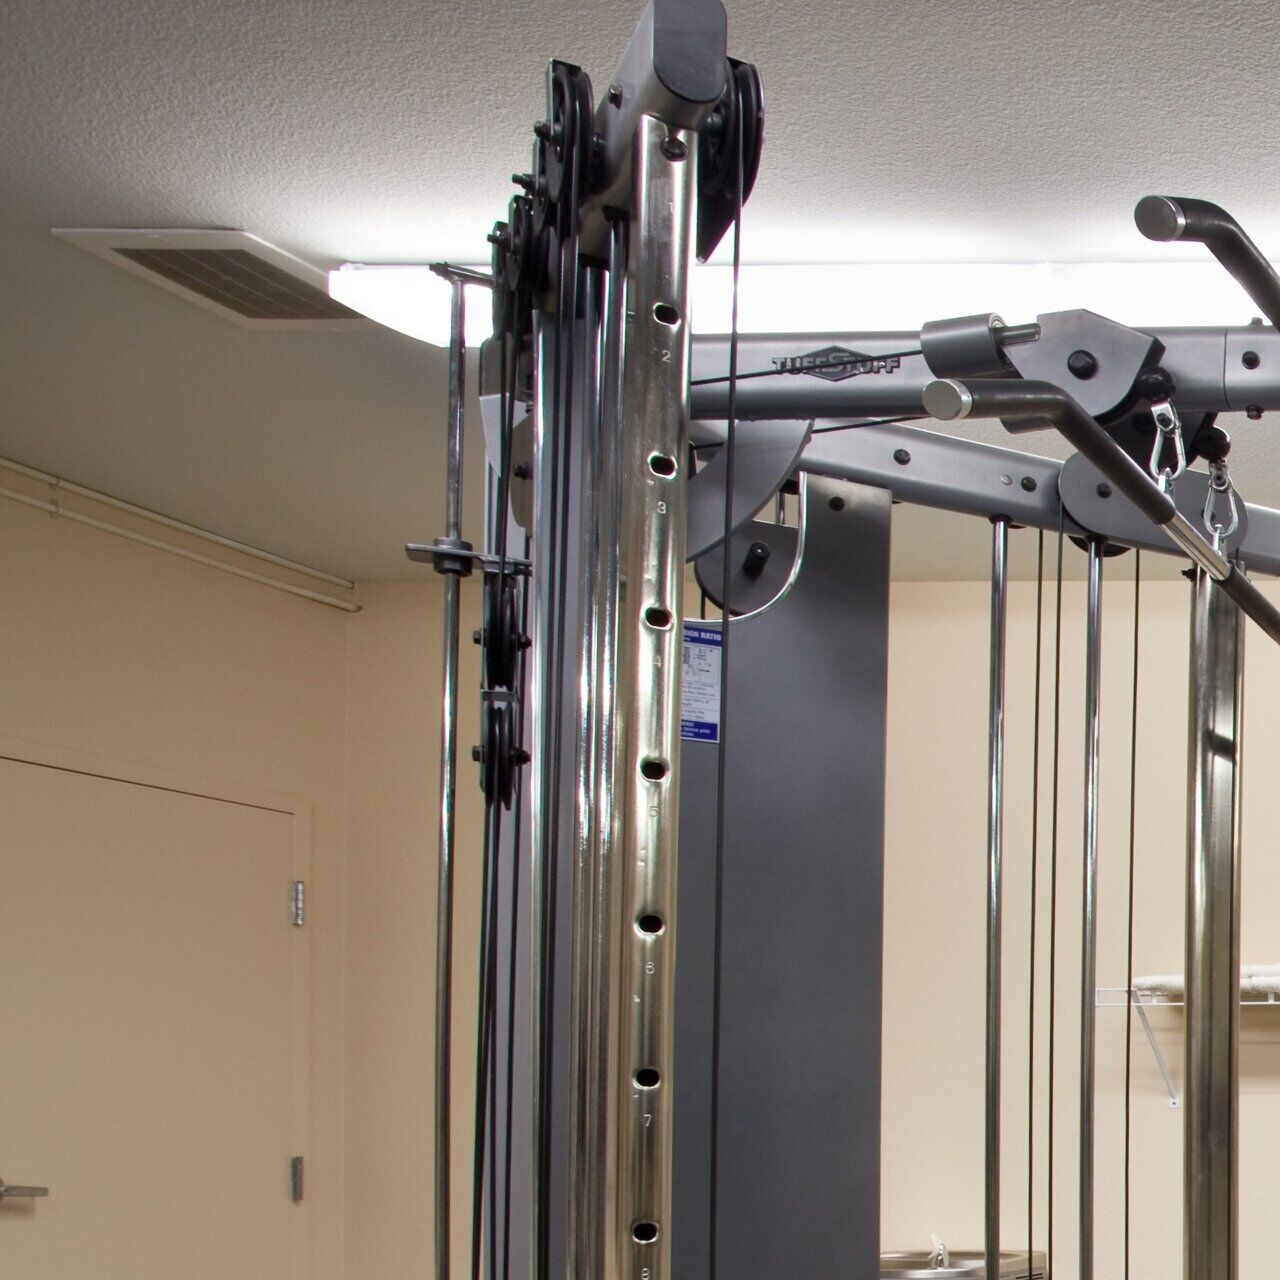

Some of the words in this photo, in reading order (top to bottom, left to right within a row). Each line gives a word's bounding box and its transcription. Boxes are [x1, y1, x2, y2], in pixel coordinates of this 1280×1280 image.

[662, 349, 671, 363] 2
[657, 501, 667, 514] 3
[650, 805, 659, 818] 5
[645, 961, 655, 974] 6
[643, 1113, 652, 1127] 7
[641, 1268, 650, 1280] 8
